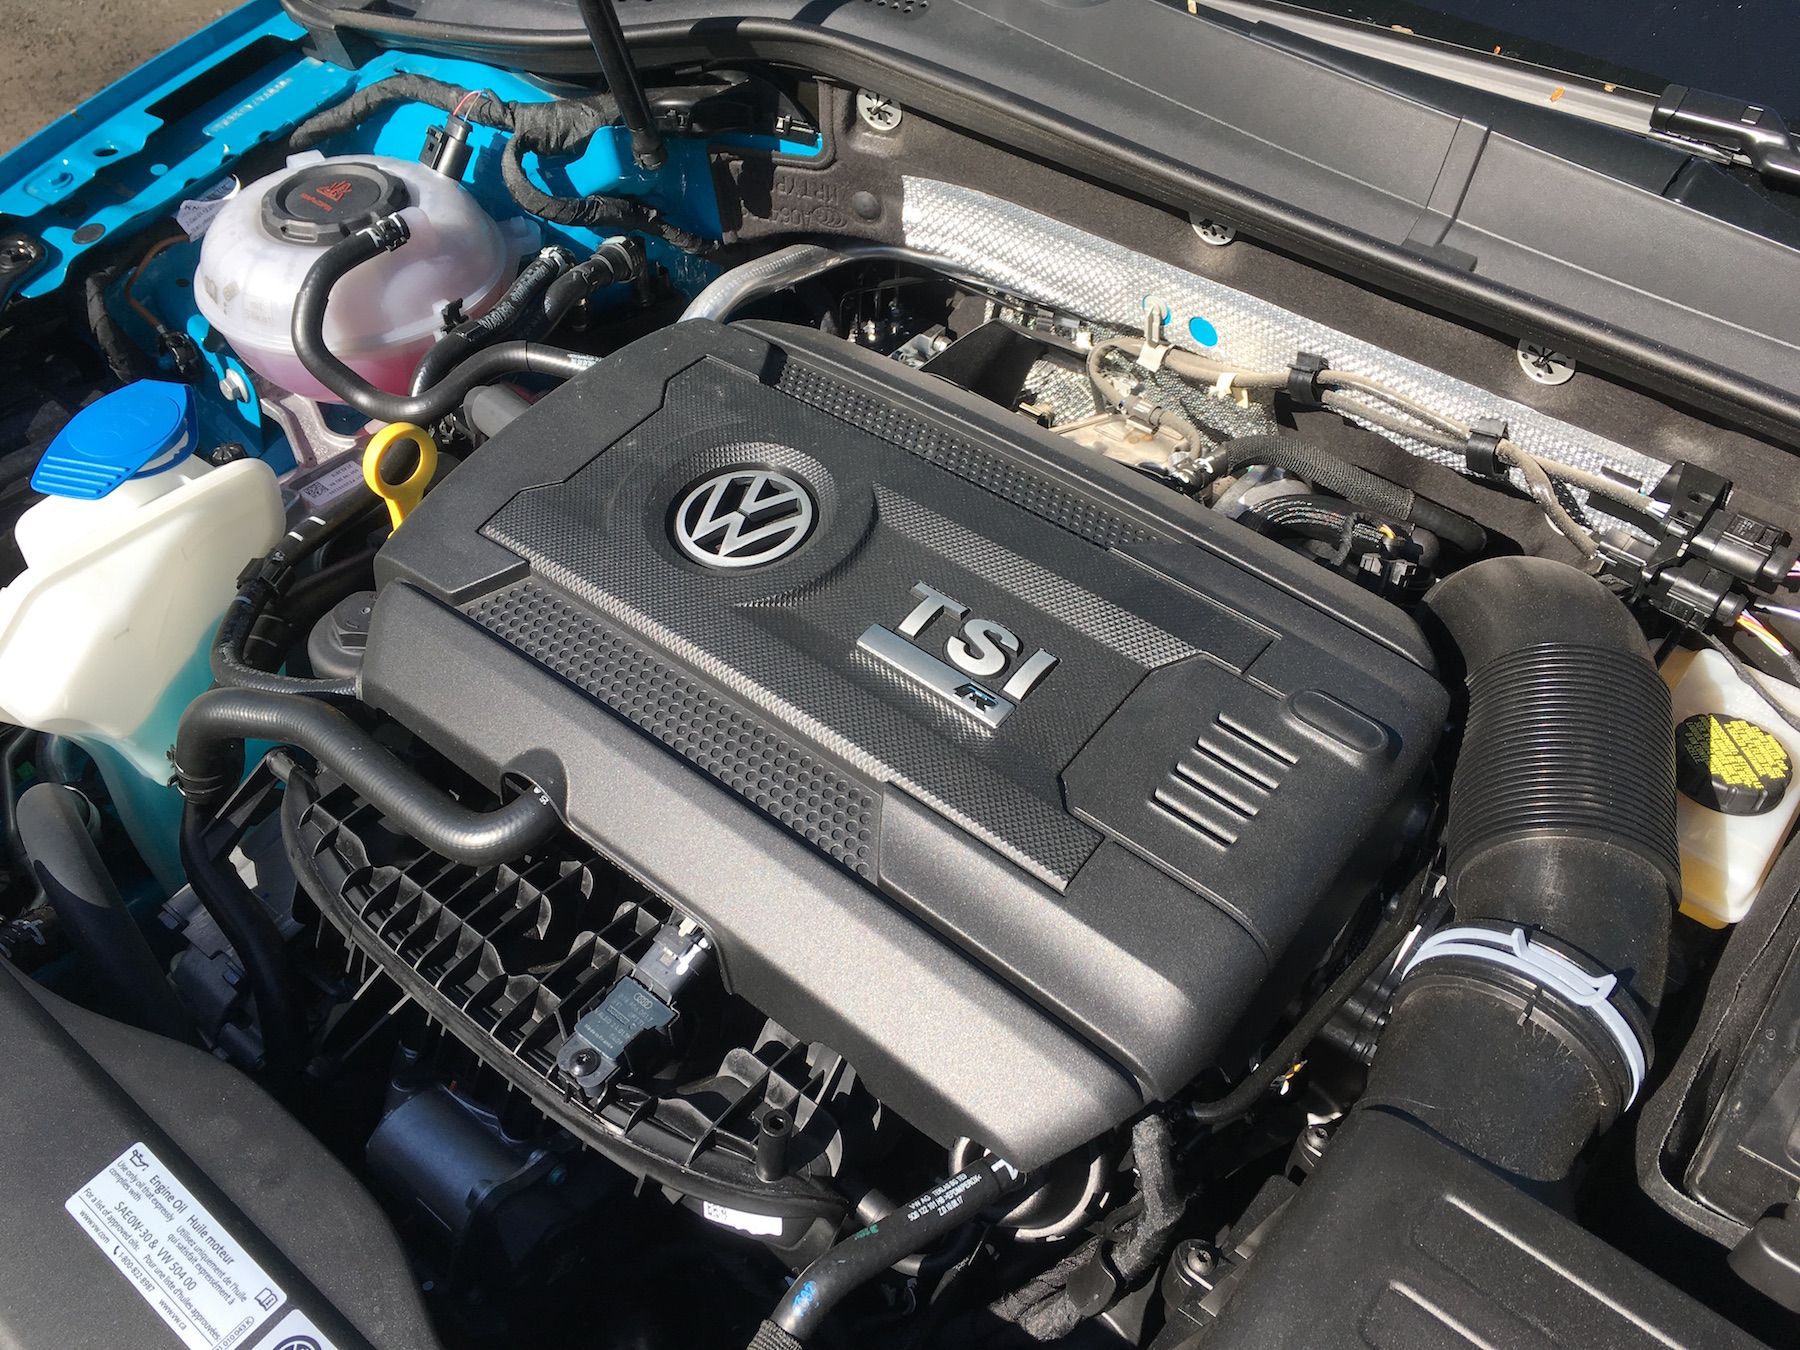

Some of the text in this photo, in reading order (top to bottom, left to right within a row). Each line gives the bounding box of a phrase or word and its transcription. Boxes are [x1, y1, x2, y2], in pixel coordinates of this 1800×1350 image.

[677, 470, 812, 567] VW
[899, 580, 1062, 703] TSI
[108, 1168, 142, 1202] complies with
[116, 1160, 175, 1223] Use only oil that expressly
[148, 1173, 188, 1214] Engine Oil
[908, 1199, 921, 1210] VW
[919, 1193, 931, 1204] AG
[917, 1204, 929, 1215] 122
[78, 1209, 110, 1244] www.vw.com
[83, 1187, 93, 1199] For
[93, 1199, 104, 1210] list
[99, 1207, 111, 1217] of
[105, 1214, 132, 1240] approved
[127, 1237, 140, 1251] oils:
[185, 1213, 234, 1266] Huile moteur
[117, 1251, 155, 1293] 1-800-822-8987
[142, 1254, 156, 1269] Pour
[153, 1266, 165, 1279] une
[162, 1275, 175, 1290] liste
[172, 1286, 193, 1310] d'huiles
[147, 1238, 159, 1250] &
[155, 1246, 174, 1266] VW
[168, 1260, 187, 1280] 504
[181, 1275, 198, 1291] 00
[166, 1233, 178, 1245] qui
[174, 1242, 197, 1265] satisfait
[193, 1263, 230, 1301] expressément
[175, 1225, 247, 1303] Utilisez uniquement de l'huile
[157, 1298, 187, 1331] www.vw.ca
